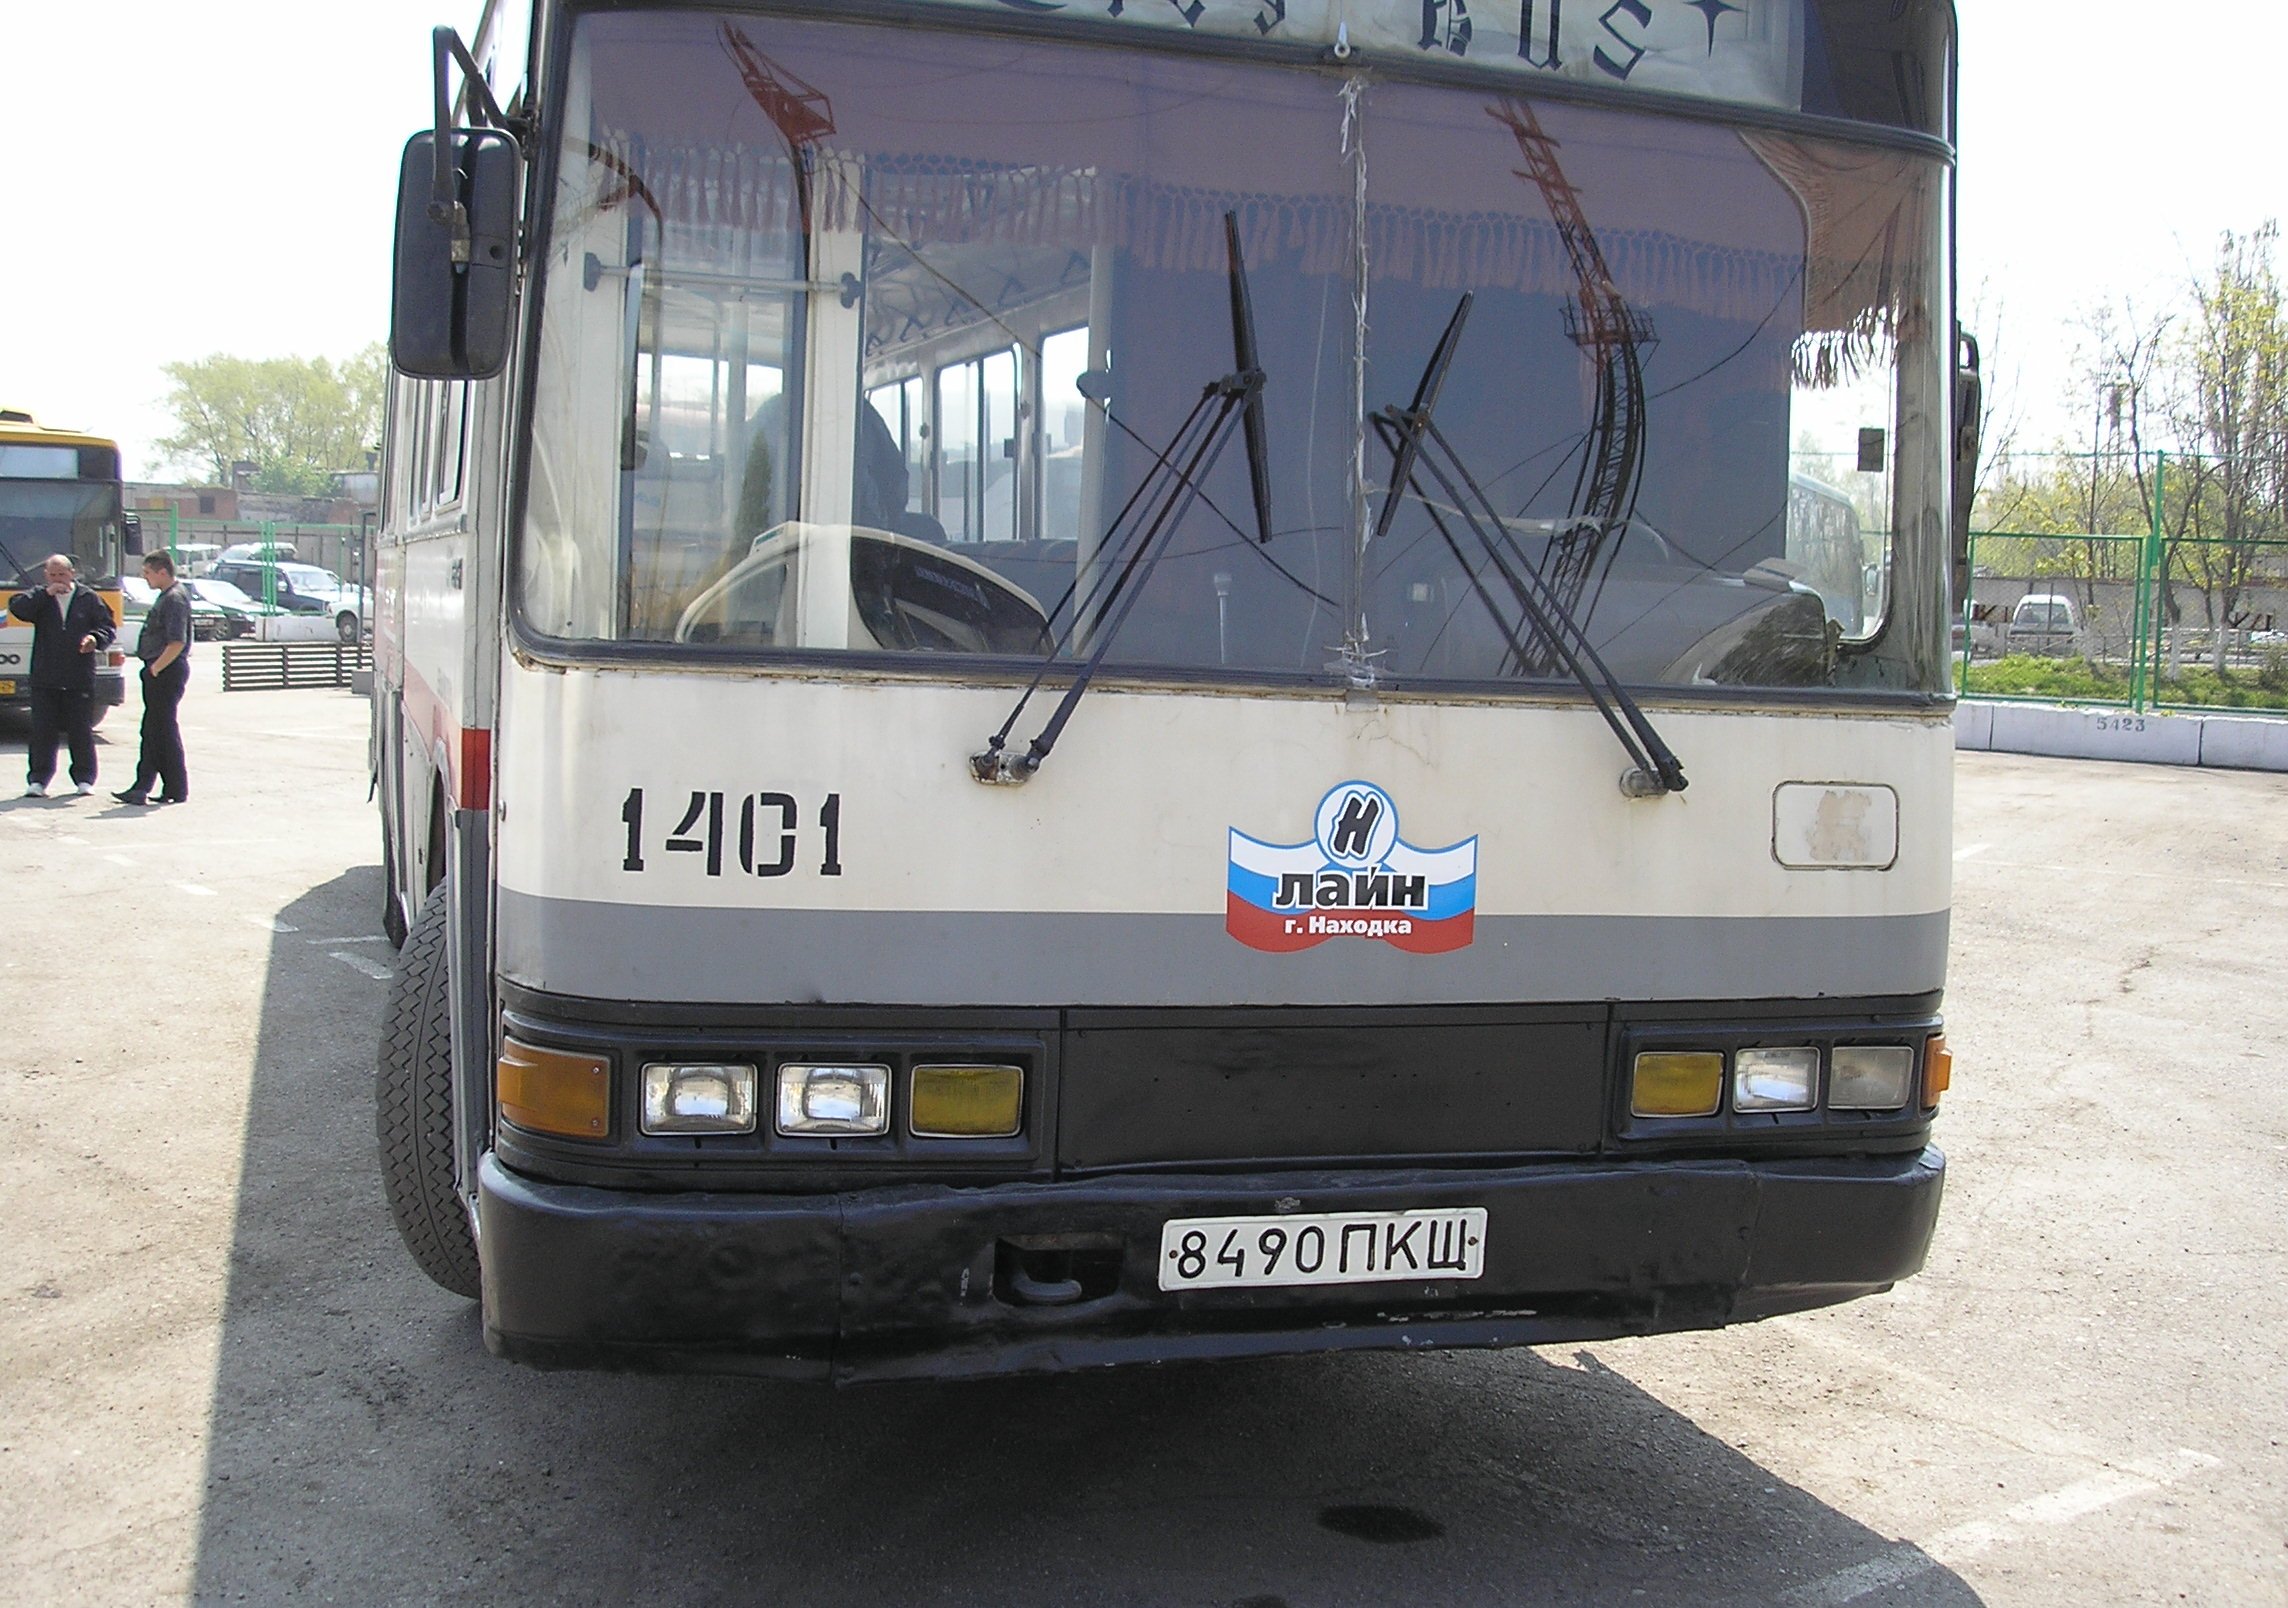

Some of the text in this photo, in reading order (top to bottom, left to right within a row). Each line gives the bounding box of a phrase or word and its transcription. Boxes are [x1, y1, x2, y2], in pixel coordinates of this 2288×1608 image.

[2096, 716, 2145, 732] 5423
[621, 788, 842, 877] 1401
[1284, 915, 1413, 937] г. Находка
